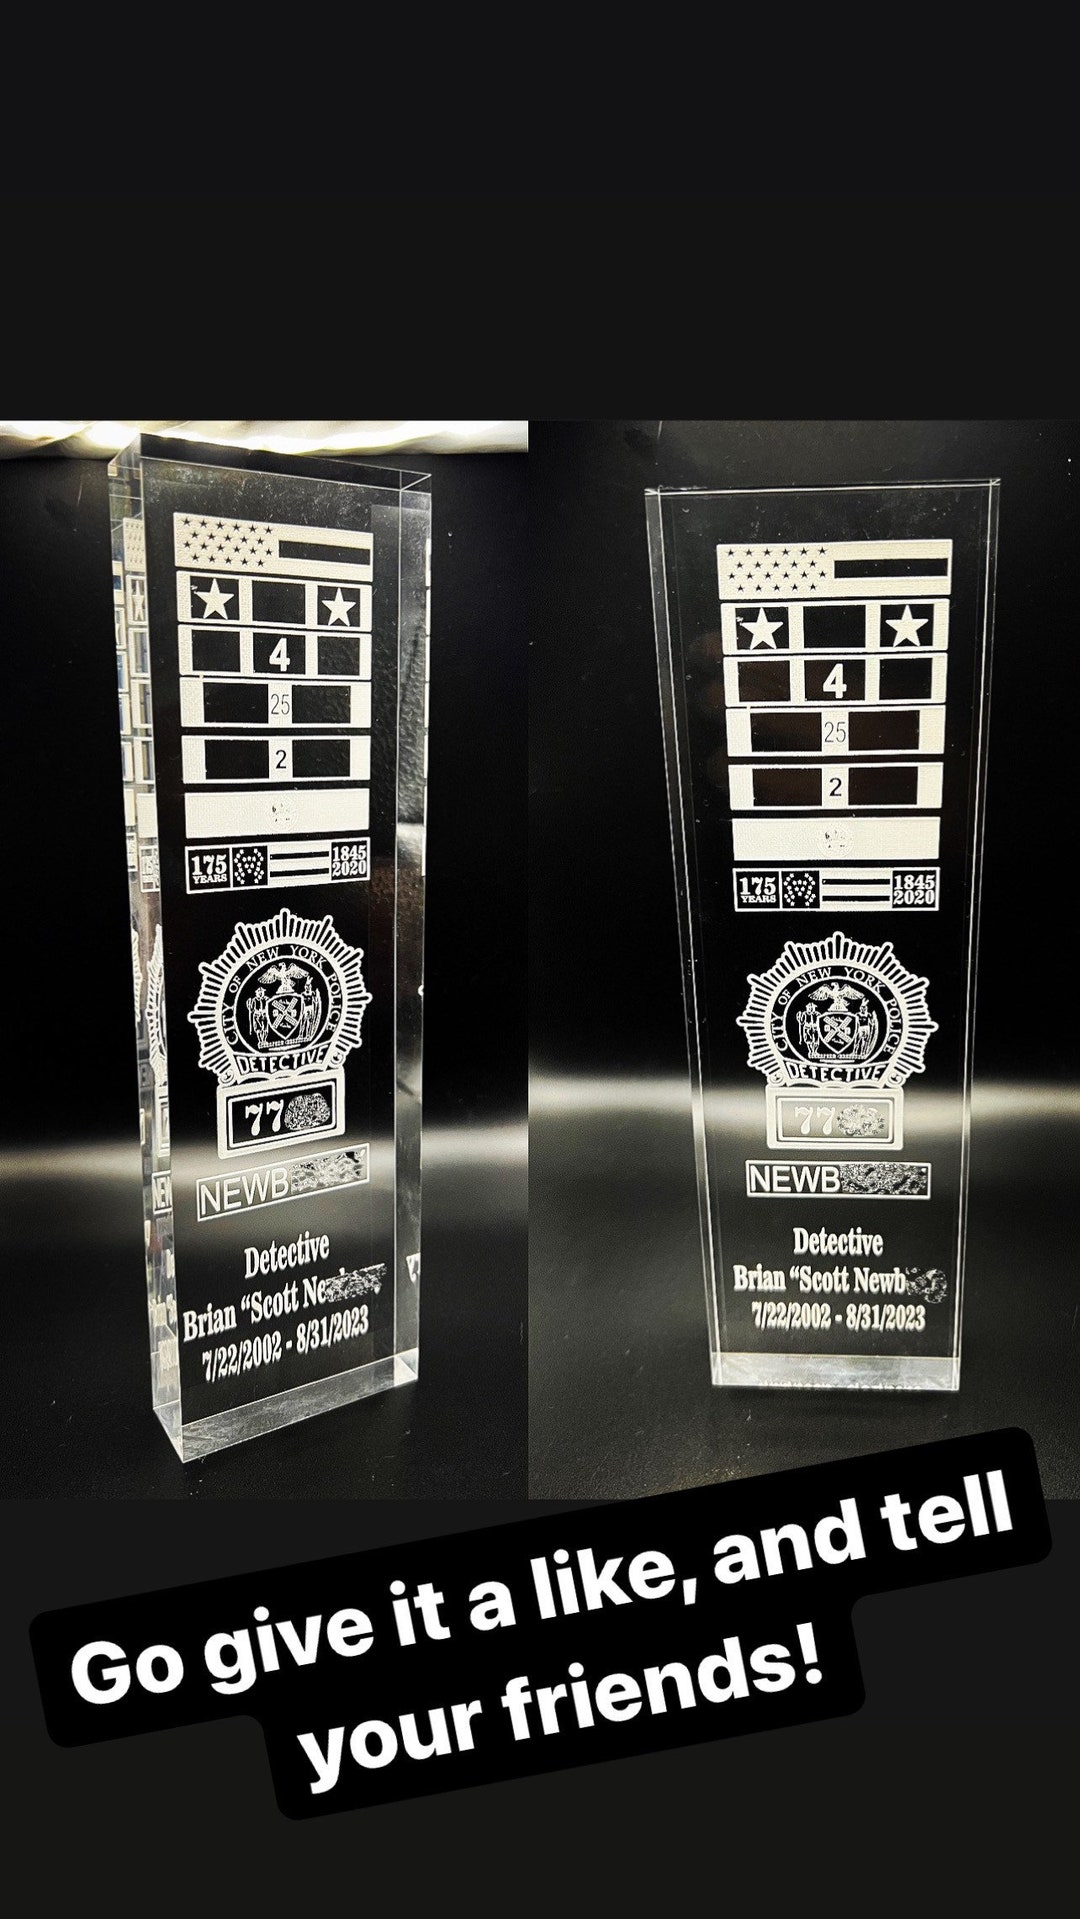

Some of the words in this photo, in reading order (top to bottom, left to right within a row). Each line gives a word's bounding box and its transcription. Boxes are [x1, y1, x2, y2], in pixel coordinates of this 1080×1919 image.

[268, 637, 291, 672] 4
[822, 663, 848, 699] 4
[270, 693, 290, 715] 25
[824, 721, 846, 743] 25
[275, 749, 287, 769] 2
[829, 777, 842, 797] 2
[191, 854, 227, 876] 175
[332, 844, 367, 862] 1845
[192, 873, 228, 885] YEARS
[332, 859, 367, 877] 2020
[739, 876, 776, 896] 175
[893, 874, 936, 890] 1845
[740, 894, 776, 903] YEARS
[893, 887, 936, 905] 2020
[245, 946, 280, 972] NEW
[290, 945, 328, 970] YORK
[228, 975, 242, 994] OF
[795, 967, 832, 988] NEW
[844, 967, 886, 994] YORK
[325, 973, 342, 1032] POLICE
[777, 989, 792, 1006] OF
[222, 1002, 239, 1046] CITY
[771, 1011, 789, 1052] CITY
[883, 998, 902, 1055] POLICE
[236, 1044, 329, 1075] DETECTIVE
[787, 1063, 887, 1083] DETECTIVE
[245, 1099, 284, 1136] 77
[794, 1105, 835, 1135] 77
[244, 1230, 330, 1279] Detective
[793, 1227, 883, 1257] Detective
[733, 1263, 787, 1293] Brian
[182, 1303, 237, 1343] Brian
[751, 1300, 832, 1332] 7/22/2002
[834, 1313, 843, 1324] -
[846, 1303, 926, 1333] 8/31/2023
[202, 1331, 283, 1383] 7/22/2002
[285, 1339, 293, 1350] -
[296, 1304, 369, 1355] 8/31/2023
